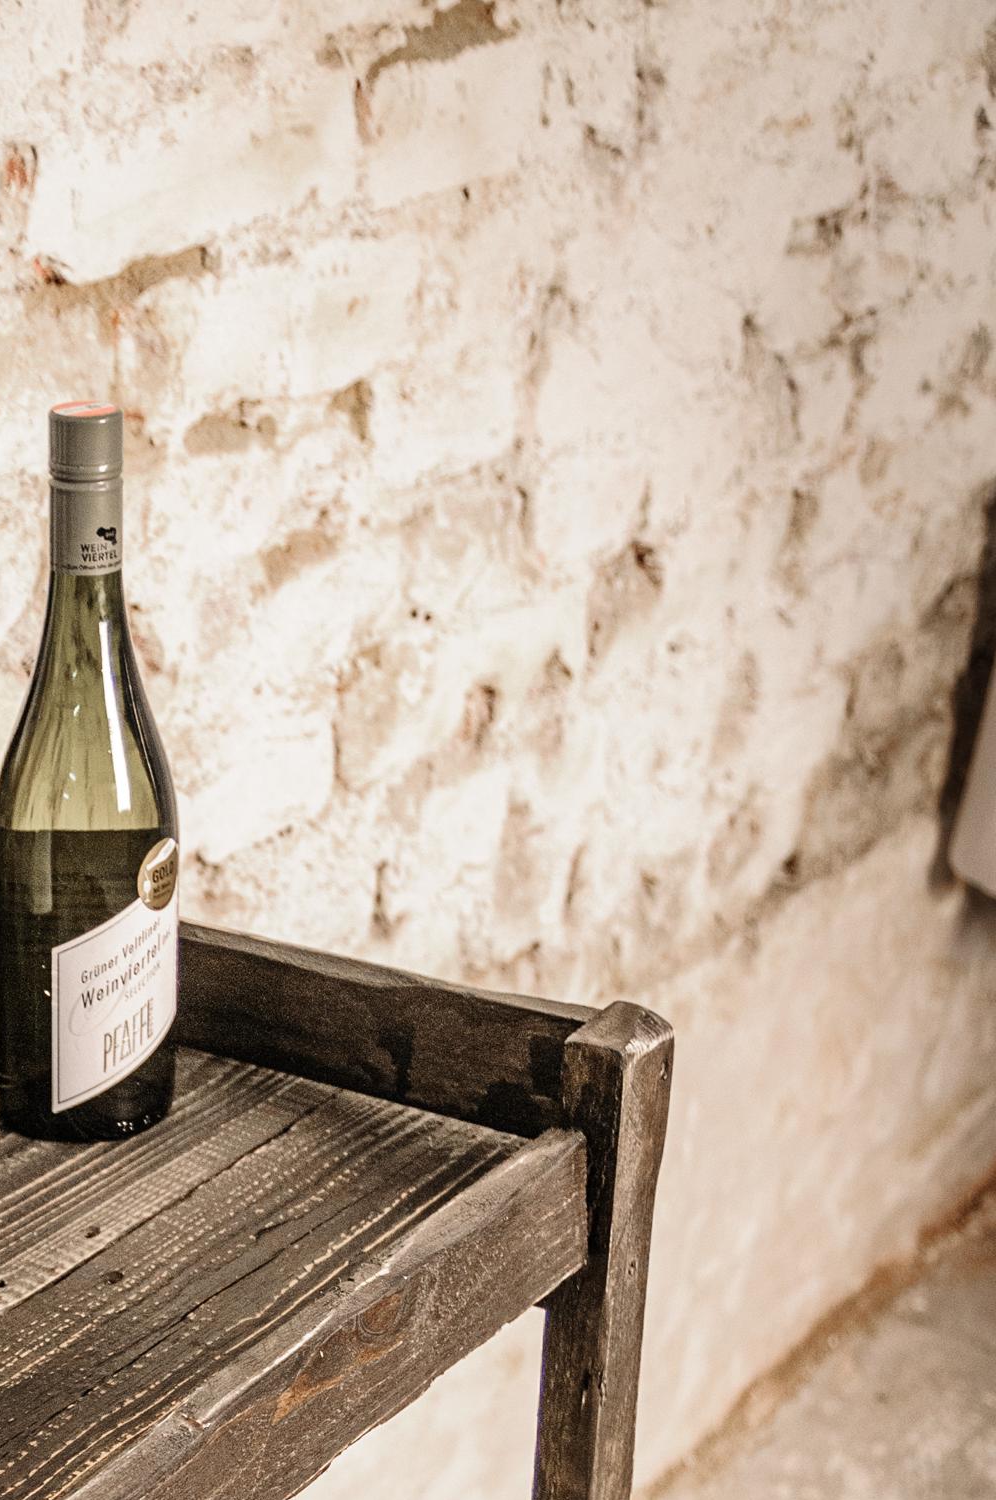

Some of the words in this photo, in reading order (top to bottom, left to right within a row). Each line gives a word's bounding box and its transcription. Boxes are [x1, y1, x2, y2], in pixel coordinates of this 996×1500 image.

[81, 543, 108, 553] WEIN
[82, 550, 117, 562] VIERTEL
[152, 861, 174, 883] GOLD
[81, 955, 119, 984] Grüner
[122, 918, 161, 959] Veltliner
[81, 934, 162, 1009] Weinviertel
